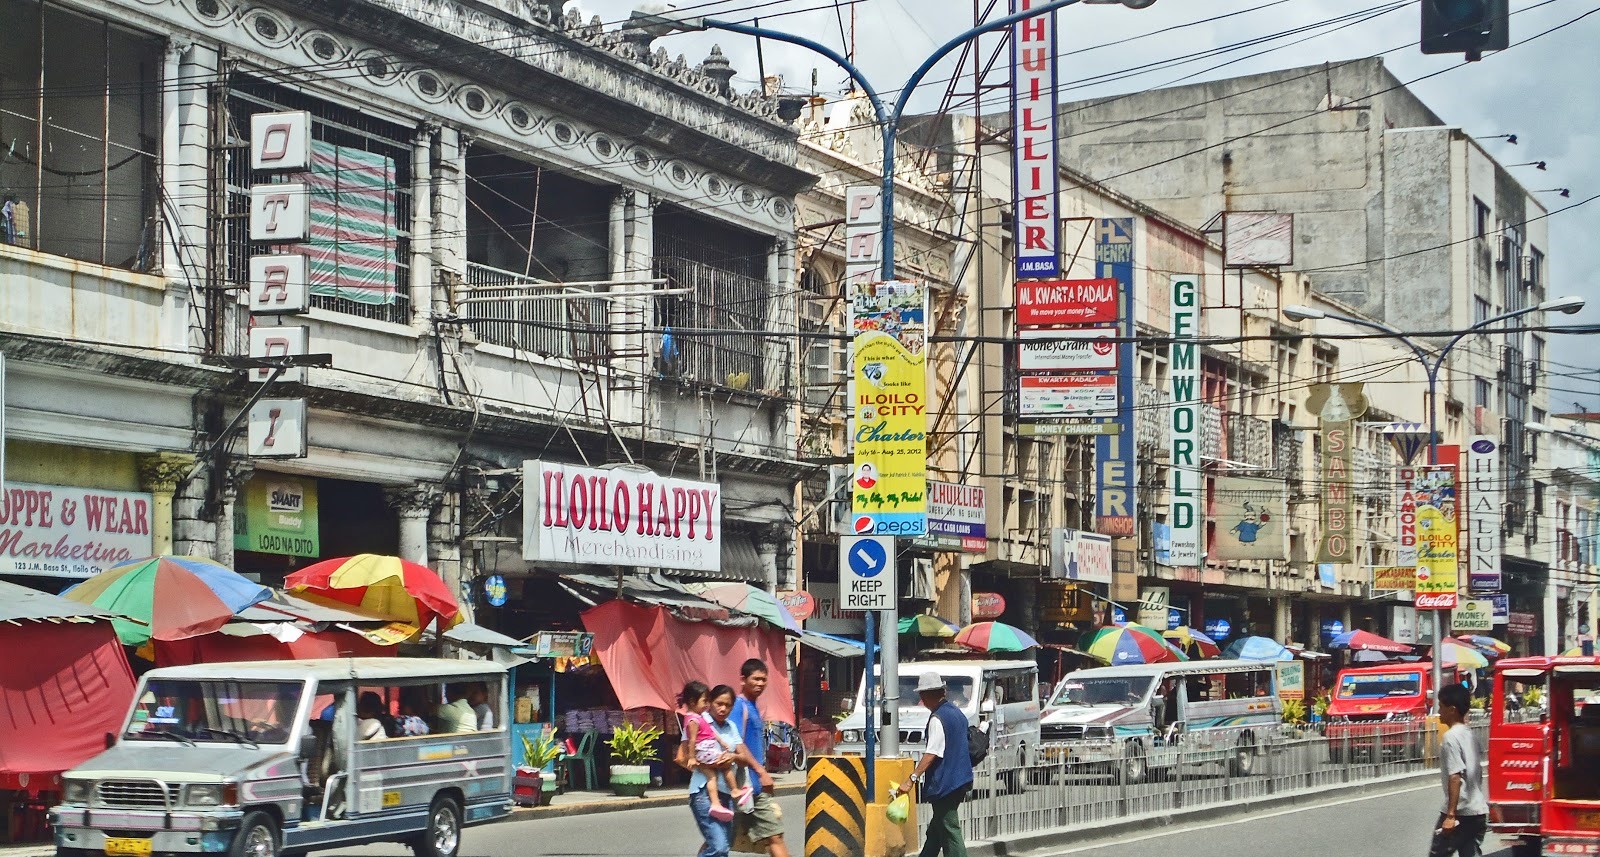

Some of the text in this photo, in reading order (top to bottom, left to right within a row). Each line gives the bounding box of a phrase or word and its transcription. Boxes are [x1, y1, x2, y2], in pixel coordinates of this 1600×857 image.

[1096, 244, 1132, 262] HENRY
[1035, 261, 1054, 271] BASA
[1020, 284, 1113, 305] ML KWARTA PADALA
[1030, 308, 1039, 316] We
[1054, 309, 1066, 317] your
[1023, 339, 1089, 353] MoneyGram
[860, 394, 918, 405] ILOILO
[1173, 281, 1194, 530] GEMWORLD
[877, 405, 925, 416] CITY
[855, 420, 925, 443] Charter
[1034, 424, 1103, 434] MONEY CHANGER
[271, 491, 301, 507] SMART
[933, 483, 984, 508] LHUILLIER
[1328, 430, 1346, 557] SAMBO
[543, 470, 717, 541] ILOILO HAPPY
[1400, 469, 1416, 547] DIAMOND
[60, 499, 77, 526] &
[84, 494, 149, 536] WEAR
[1475, 458, 1494, 571] HUALUN
[876, 518, 923, 534] pepsi
[943, 522, 956, 532] CASH
[956, 523, 970, 534] LOANS
[259, 534, 313, 554] LOAD NA DITO
[564, 536, 703, 567] Merchandising
[1171, 540, 1196, 549] Pawnshop
[14, 562, 26, 570] 123
[28, 562, 40, 571] J.M.
[43, 563, 59, 572] Basa
[73, 565, 89, 573] Iloilo
[90, 565, 103, 575] City
[852, 580, 882, 592] KEEP
[848, 594, 887, 606] RIGHT
[1453, 620, 1489, 628] CHANGER
[1456, 612, 1486, 620] MONEY
